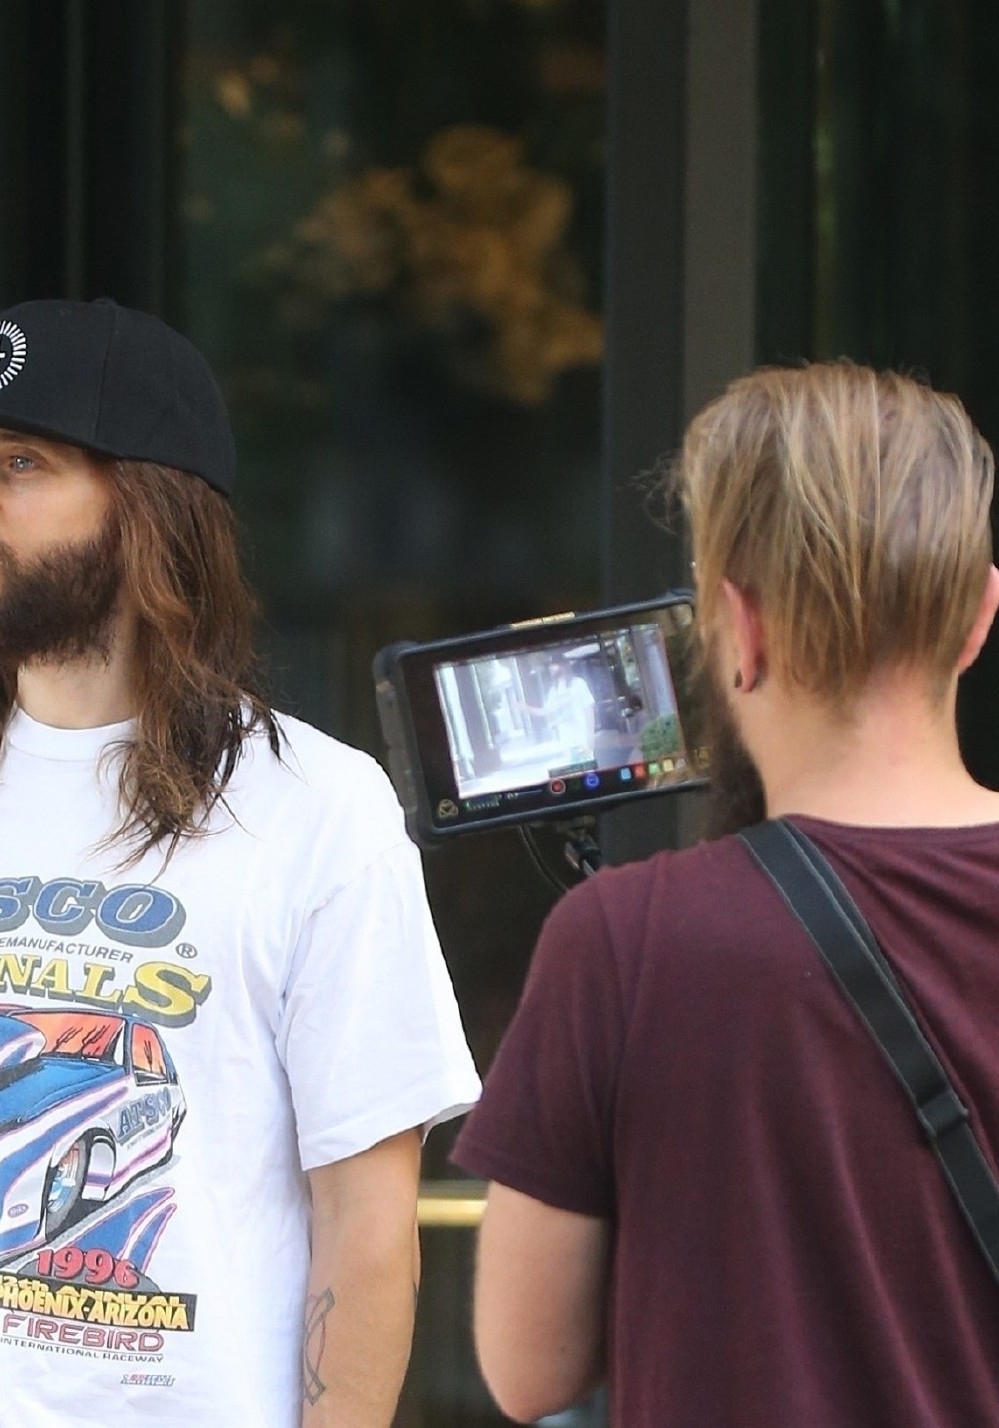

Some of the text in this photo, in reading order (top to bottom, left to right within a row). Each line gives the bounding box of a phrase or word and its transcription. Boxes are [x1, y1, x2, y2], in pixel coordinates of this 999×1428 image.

[36, 1246, 140, 1289] 1996
[0, 1337, 163, 1363] INTERNATIONAL RACEWAY
[2, 1313, 165, 1352] FIREBIRD
